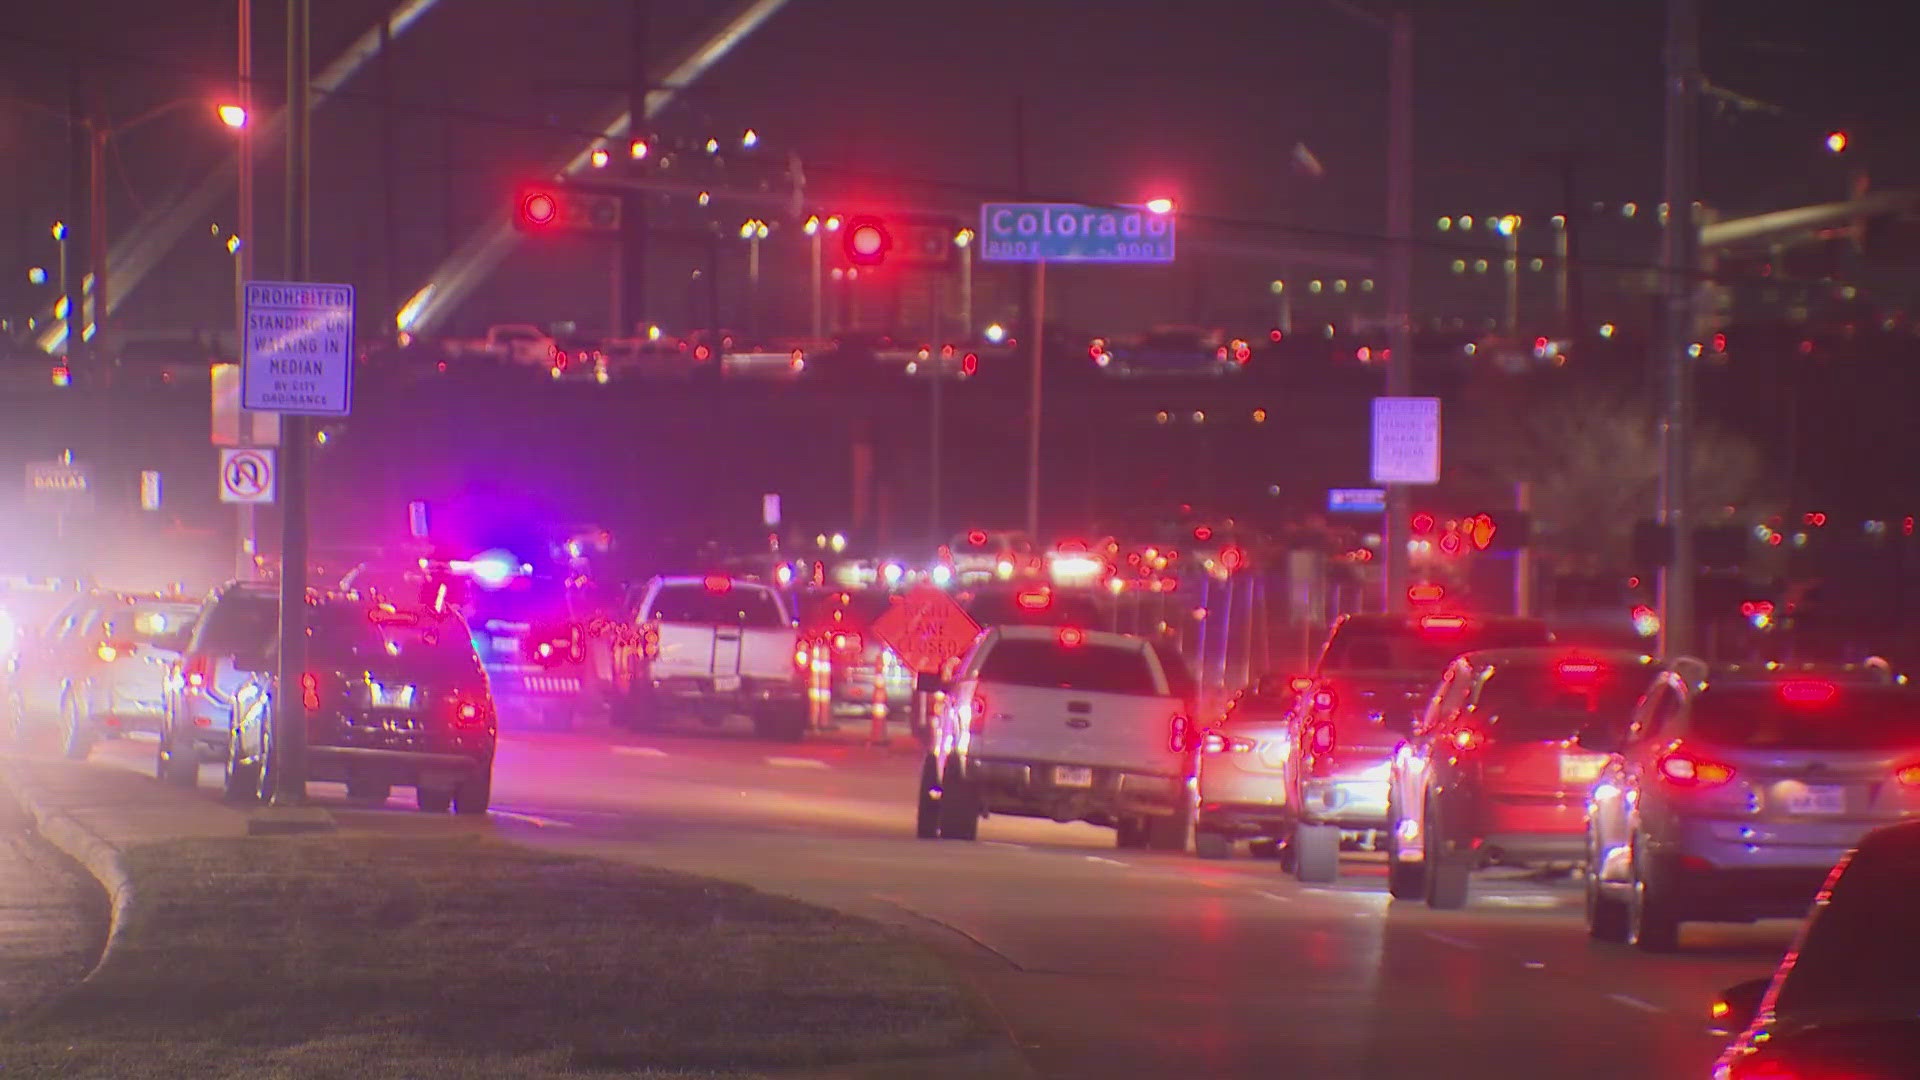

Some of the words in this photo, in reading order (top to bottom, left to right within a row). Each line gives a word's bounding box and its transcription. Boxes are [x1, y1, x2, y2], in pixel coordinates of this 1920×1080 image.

[991, 208, 1166, 237] Colorado
[251, 287, 345, 306] PROHIBITED
[250, 313, 320, 332] STANDING
[254, 336, 318, 354] WAKING
[324, 338, 340, 353] IN
[269, 358, 323, 376] MEDIAN
[273, 380, 288, 391] BY
